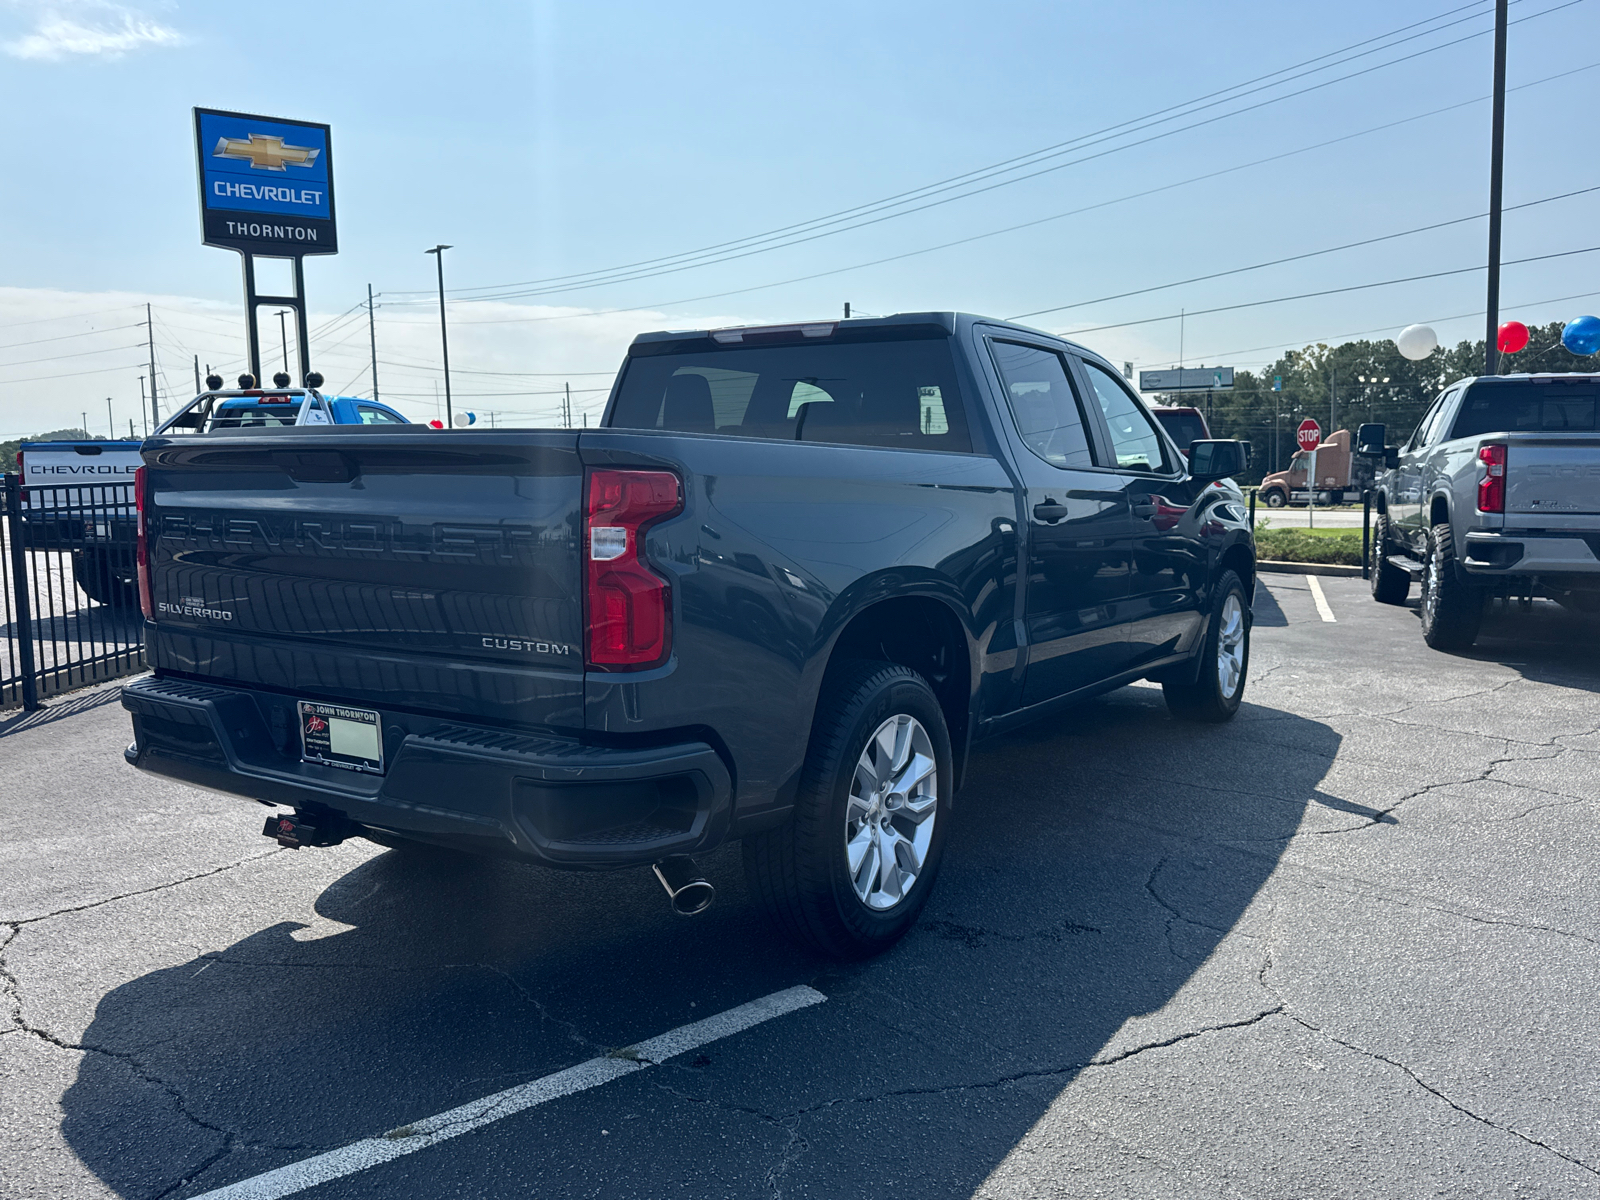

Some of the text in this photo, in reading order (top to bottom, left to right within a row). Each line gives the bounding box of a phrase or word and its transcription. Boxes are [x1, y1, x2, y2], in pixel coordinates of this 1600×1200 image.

[214, 181, 323, 205] CHEVROLET
[226, 221, 317, 241] THORNTON
[1299, 429, 1319, 442] STOP
[30, 465, 140, 474] CHEVROLE
[161, 513, 533, 558] CHEVROLET
[159, 602, 232, 621] SILVERADO
[482, 637, 569, 655] CUSTOM
[316, 705, 375, 721] JOHN THORNTON
